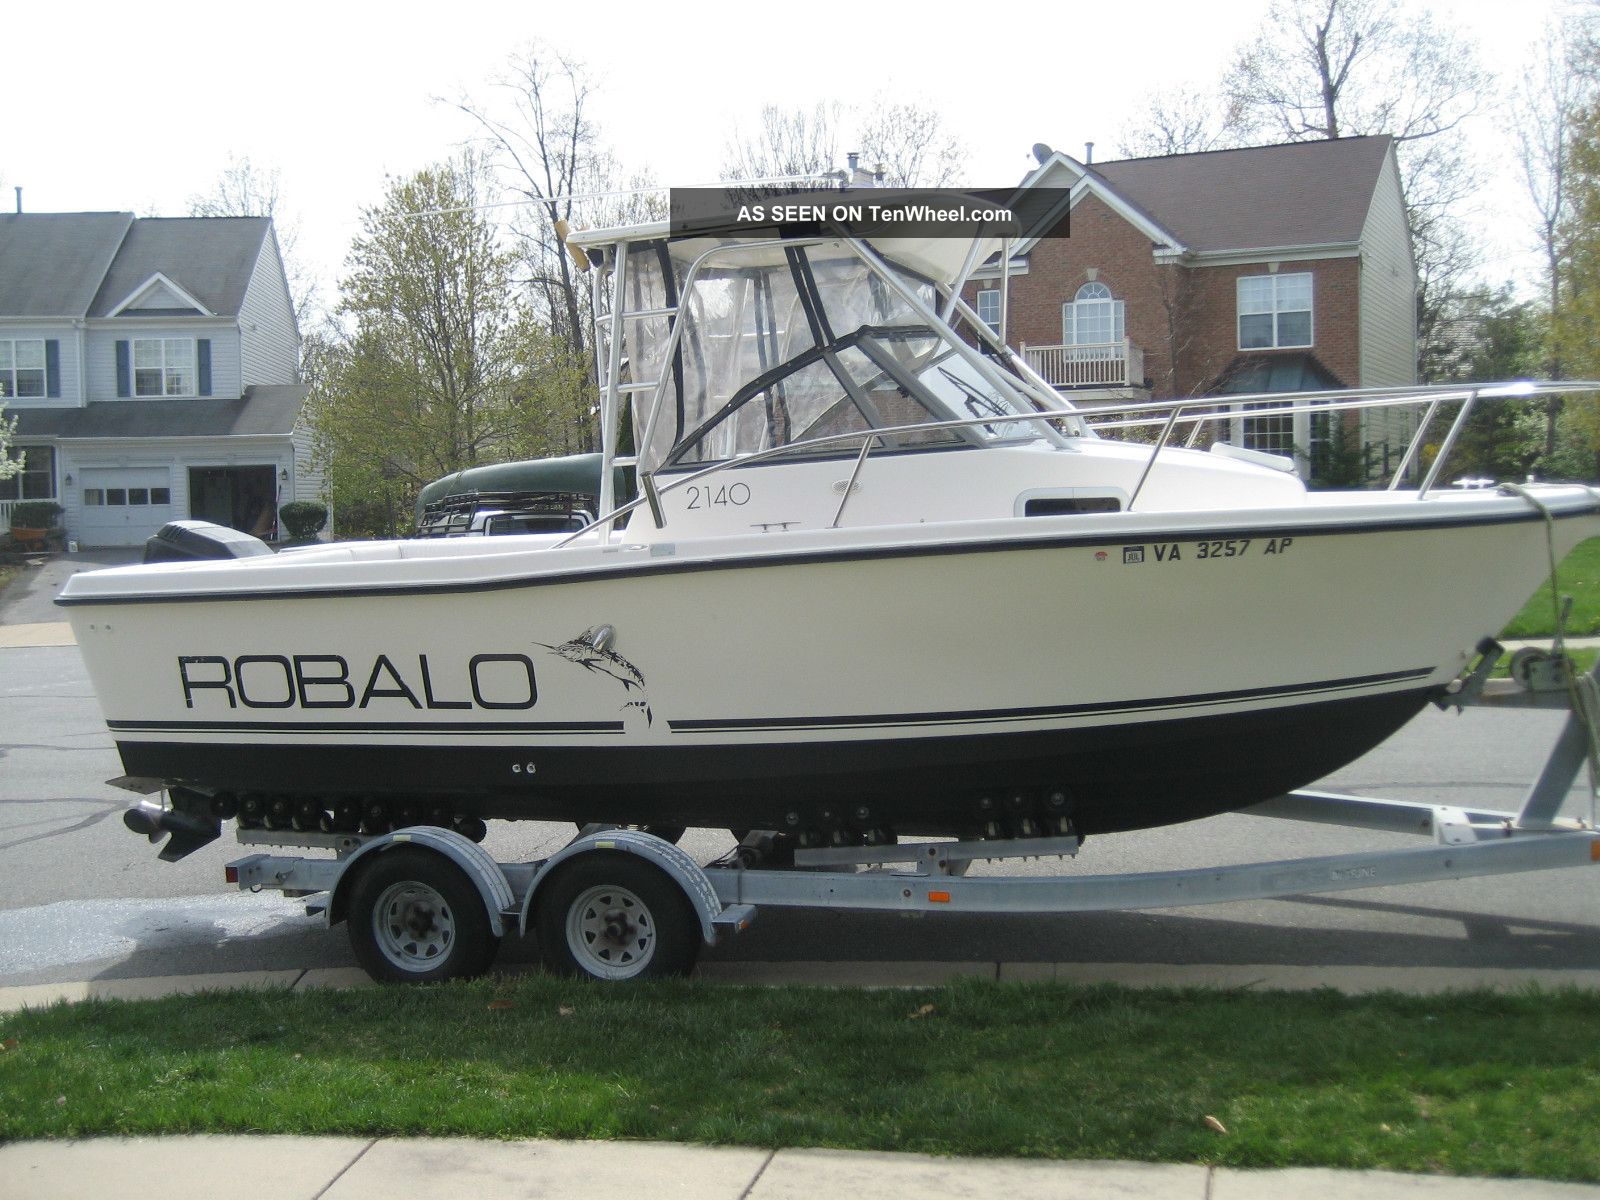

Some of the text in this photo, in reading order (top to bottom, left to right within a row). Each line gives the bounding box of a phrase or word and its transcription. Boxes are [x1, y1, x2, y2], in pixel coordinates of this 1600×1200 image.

[686, 482, 751, 510] 2140
[1153, 537, 1293, 562] VA 3257 AP
[177, 653, 538, 710] ROBALO
